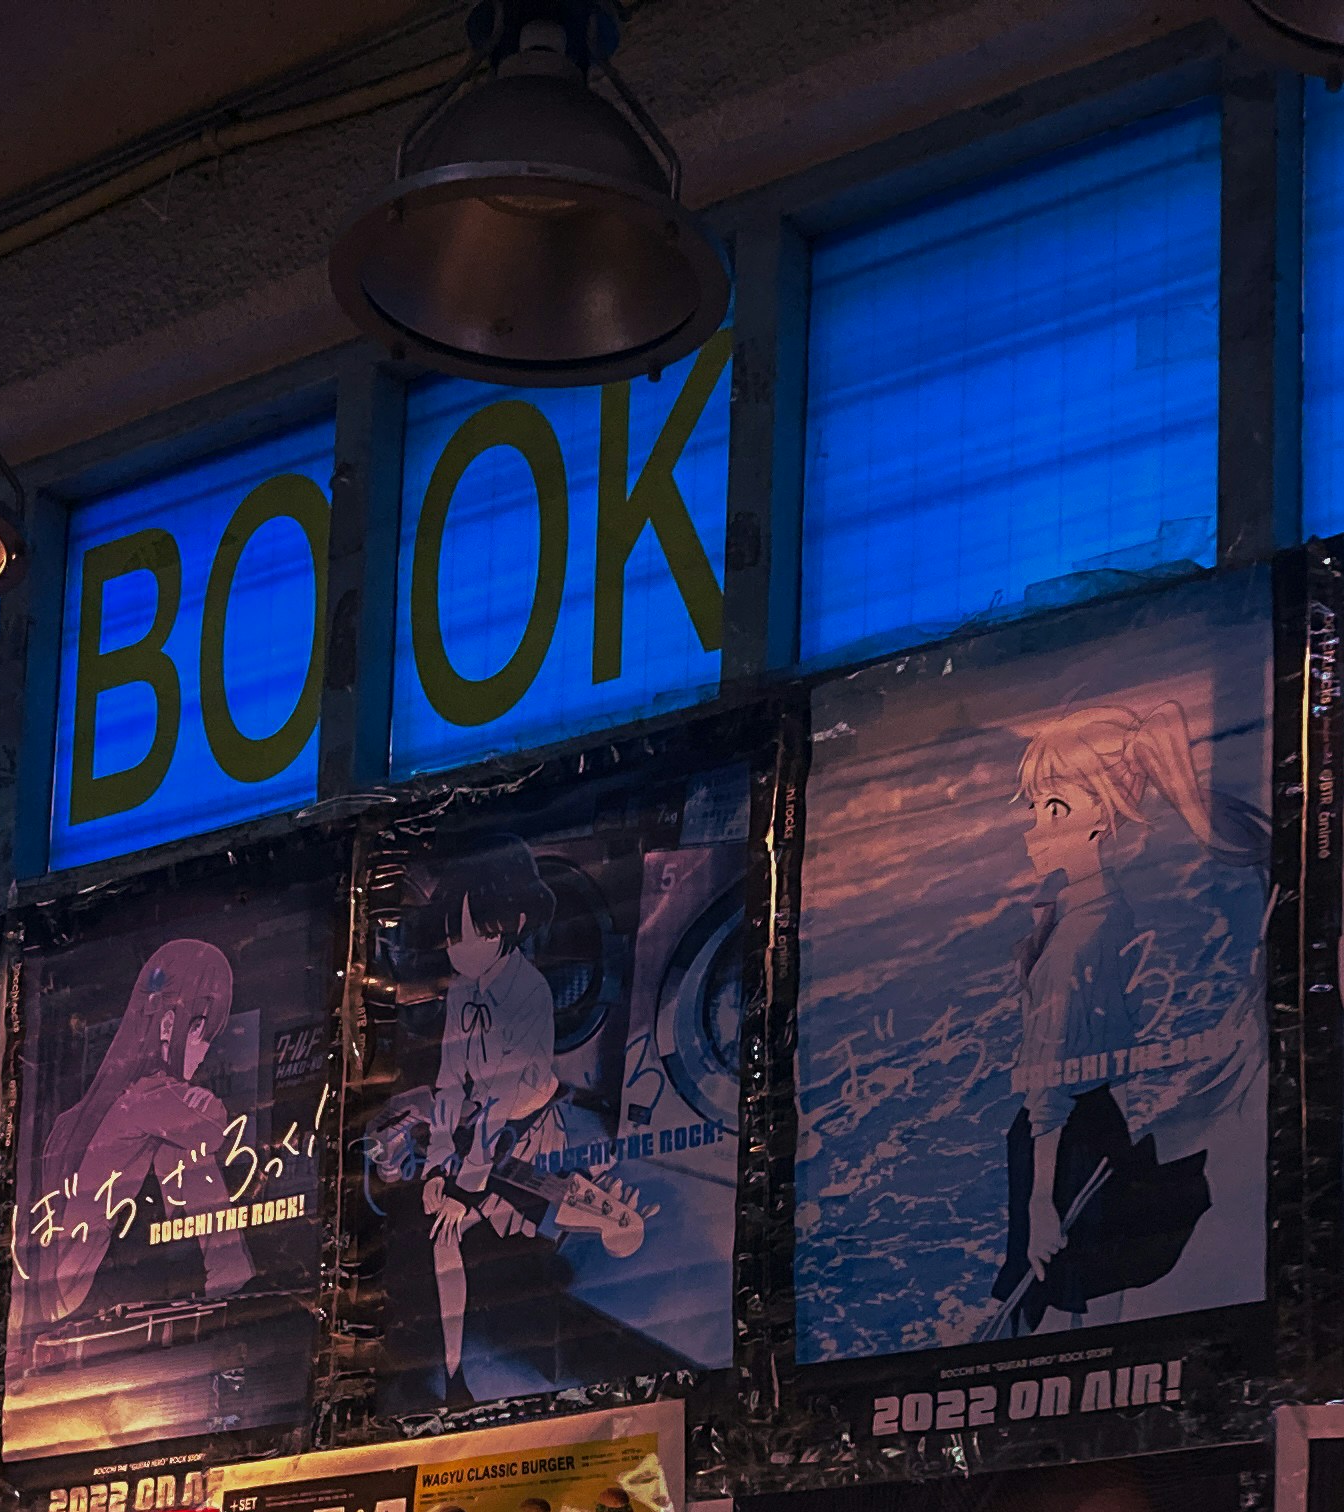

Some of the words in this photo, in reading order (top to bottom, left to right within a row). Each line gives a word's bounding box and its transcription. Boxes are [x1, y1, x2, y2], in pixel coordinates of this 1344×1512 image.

[69, 328, 733, 825] BOOK
[660, 1119, 725, 1151] ROCK!
[150, 1214, 212, 1245] BOCCHI
[215, 1207, 249, 1233] THE
[251, 1194, 305, 1226] ROCK!
[872, 1384, 997, 1437] 2022
[1007, 1373, 1072, 1421] ON
[1086, 1359, 1184, 1414] AIR!
[422, 1469, 466, 1489] WAGYU
[467, 1462, 518, 1484] CLASSIC
[521, 1455, 576, 1475] BURGER
